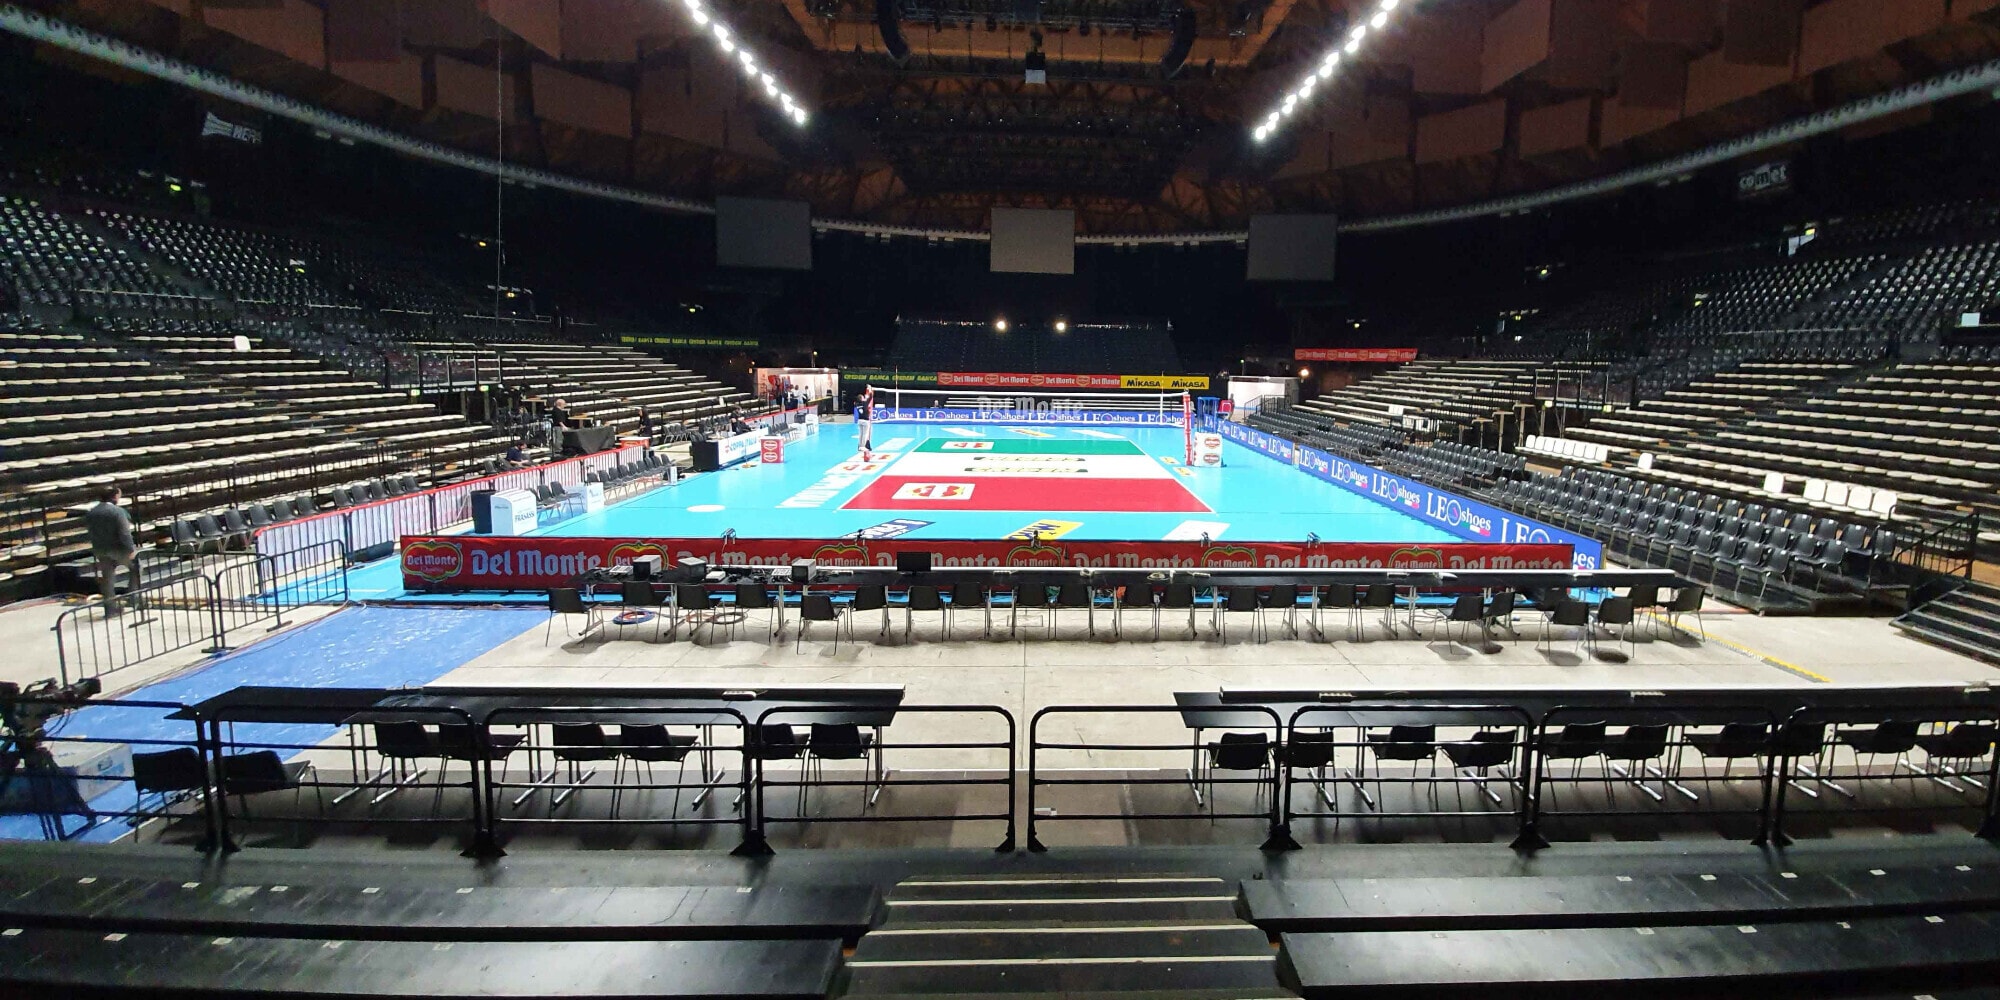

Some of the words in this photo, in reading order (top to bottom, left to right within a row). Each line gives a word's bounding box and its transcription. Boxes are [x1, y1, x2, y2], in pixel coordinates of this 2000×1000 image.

[954, 375, 964, 383] Del
[964, 375, 984, 383] Monte
[1000, 375, 1010, 383] Del
[1010, 376, 1030, 384] Monte
[1046, 376, 1055, 384] Del
[1056, 376, 1075, 384] Monte
[1091, 377, 1101, 385] Del
[1101, 377, 1120, 385] Monte
[407, 555, 424, 565] Del
[425, 555, 457, 565] Monte
[471, 549, 513, 576] Del
[516, 549, 601, 576] Monte
[615, 556, 631, 566] Del
[818, 558, 833, 566] Del
[834, 558, 864, 566] Monte
[1013, 558, 1027, 567] Del
[1028, 558, 1058, 567] Monte
[1073, 552, 1110, 568] Del
[1207, 559, 1222, 568] Del
[1223, 559, 1252, 568] Monte
[1395, 560, 1409, 568] Del
[1409, 560, 1438, 568] Monte
